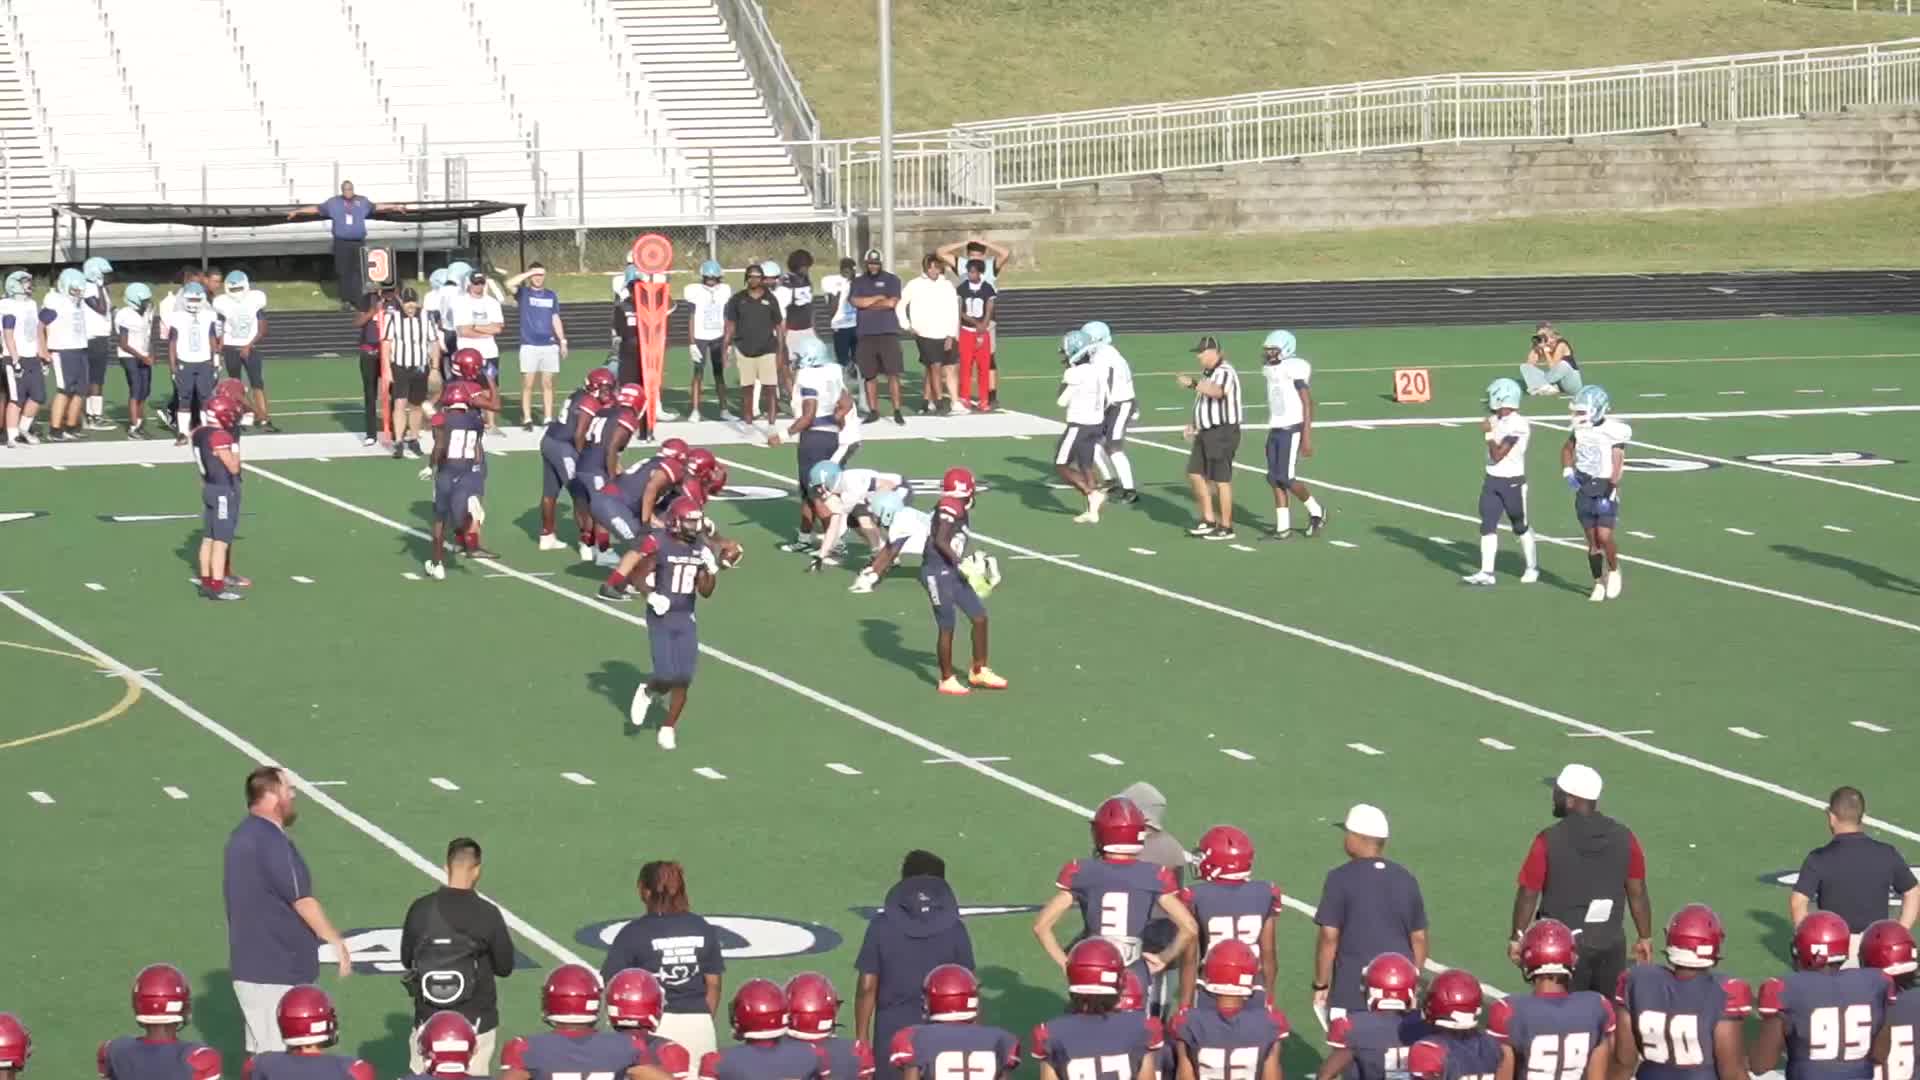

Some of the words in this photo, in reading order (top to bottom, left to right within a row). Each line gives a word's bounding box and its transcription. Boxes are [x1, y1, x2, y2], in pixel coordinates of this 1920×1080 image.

[367, 249, 391, 282] 3
[1399, 372, 1426, 395] 20
[1101, 892, 1129, 936] 3
[1527, 1032, 1591, 1080] 59
[1638, 1010, 1704, 1065] 90
[1809, 1004, 1873, 1061] 95
[1873, 1025, 1915, 1080] 6
